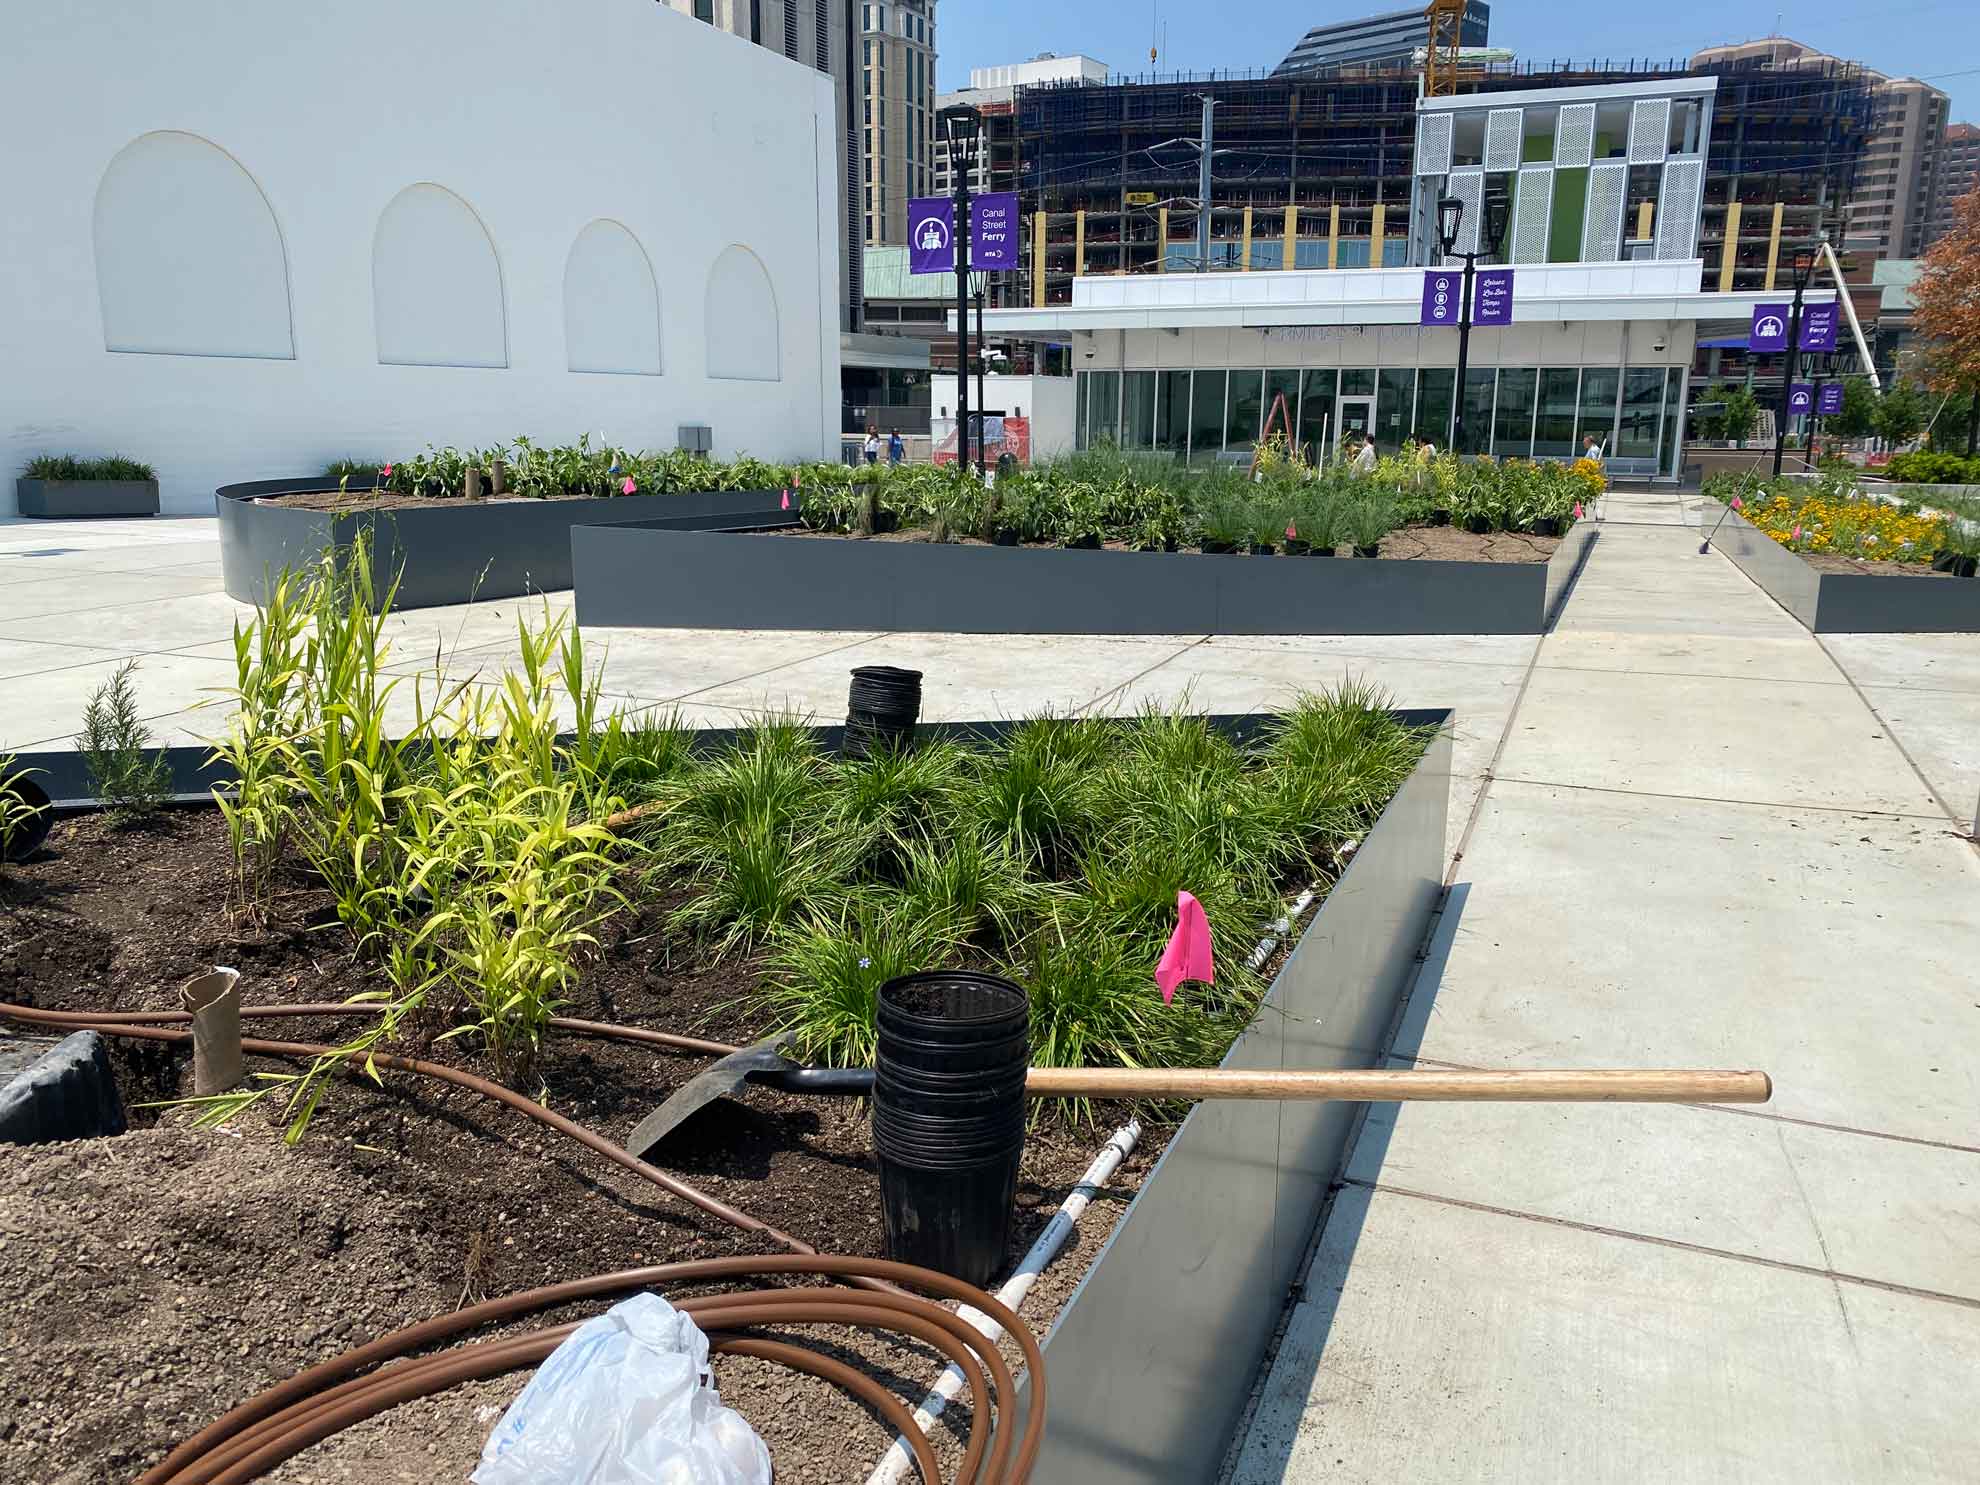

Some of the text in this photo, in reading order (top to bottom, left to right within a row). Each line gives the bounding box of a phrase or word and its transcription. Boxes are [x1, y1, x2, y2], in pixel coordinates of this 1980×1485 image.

[982, 208, 1006, 218] Canal
[982, 220, 1007, 230] Street
[982, 232, 1006, 242] Ferry
